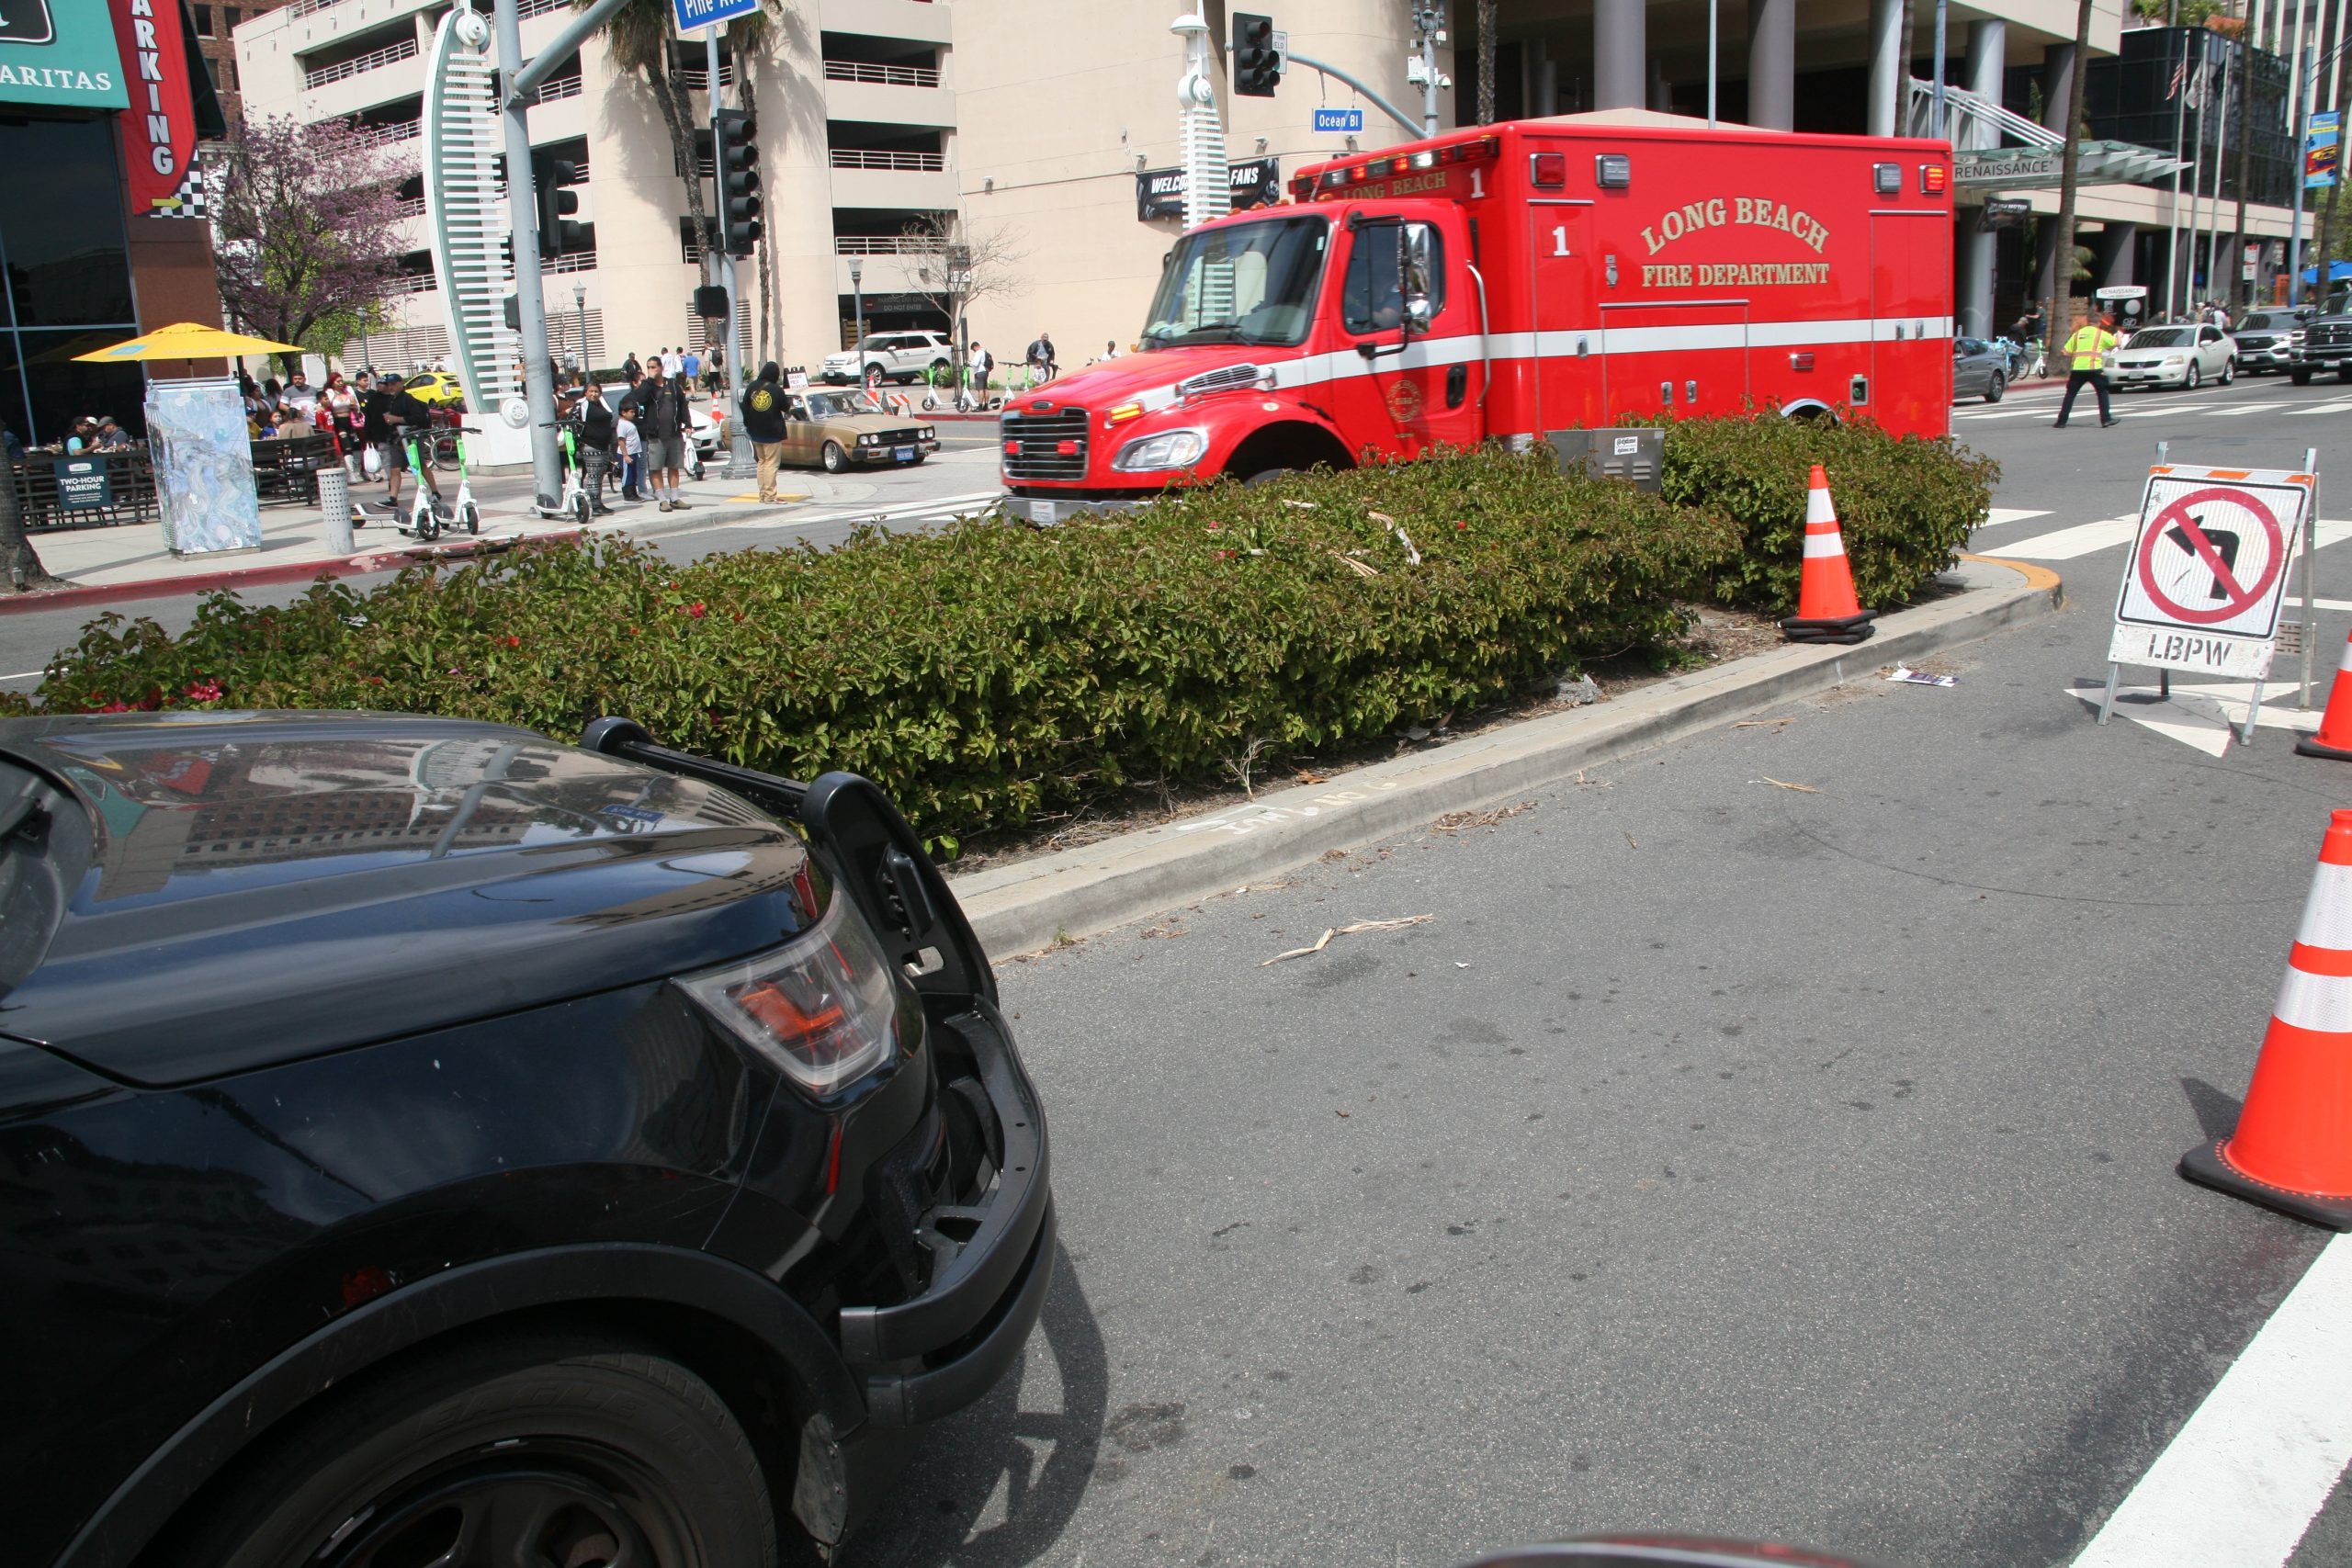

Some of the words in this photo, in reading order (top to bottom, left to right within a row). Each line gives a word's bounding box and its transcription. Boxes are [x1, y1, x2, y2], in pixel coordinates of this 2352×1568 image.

[0, 64, 112, 90] ARITAS
[1319, 115, 1346, 127] Ocean
[1350, 115, 1359, 127] Bl
[1151, 175, 1188, 194] WELCO
[1230, 167, 1259, 186] FANS
[1392, 172, 1447, 196] BEACH
[1470, 167, 1485, 198] 1
[1641, 198, 1727, 255] LONG
[1735, 197, 1829, 254] BEACH
[1552, 225, 1571, 256] 1
[1642, 265, 1692, 287] FIRE
[1697, 263, 1830, 286] DEPARTMENT
[59, 476, 105, 485] TWO-HOUR
[65, 483, 101, 491] PARKING
[2147, 633, 2233, 667] LBPW
